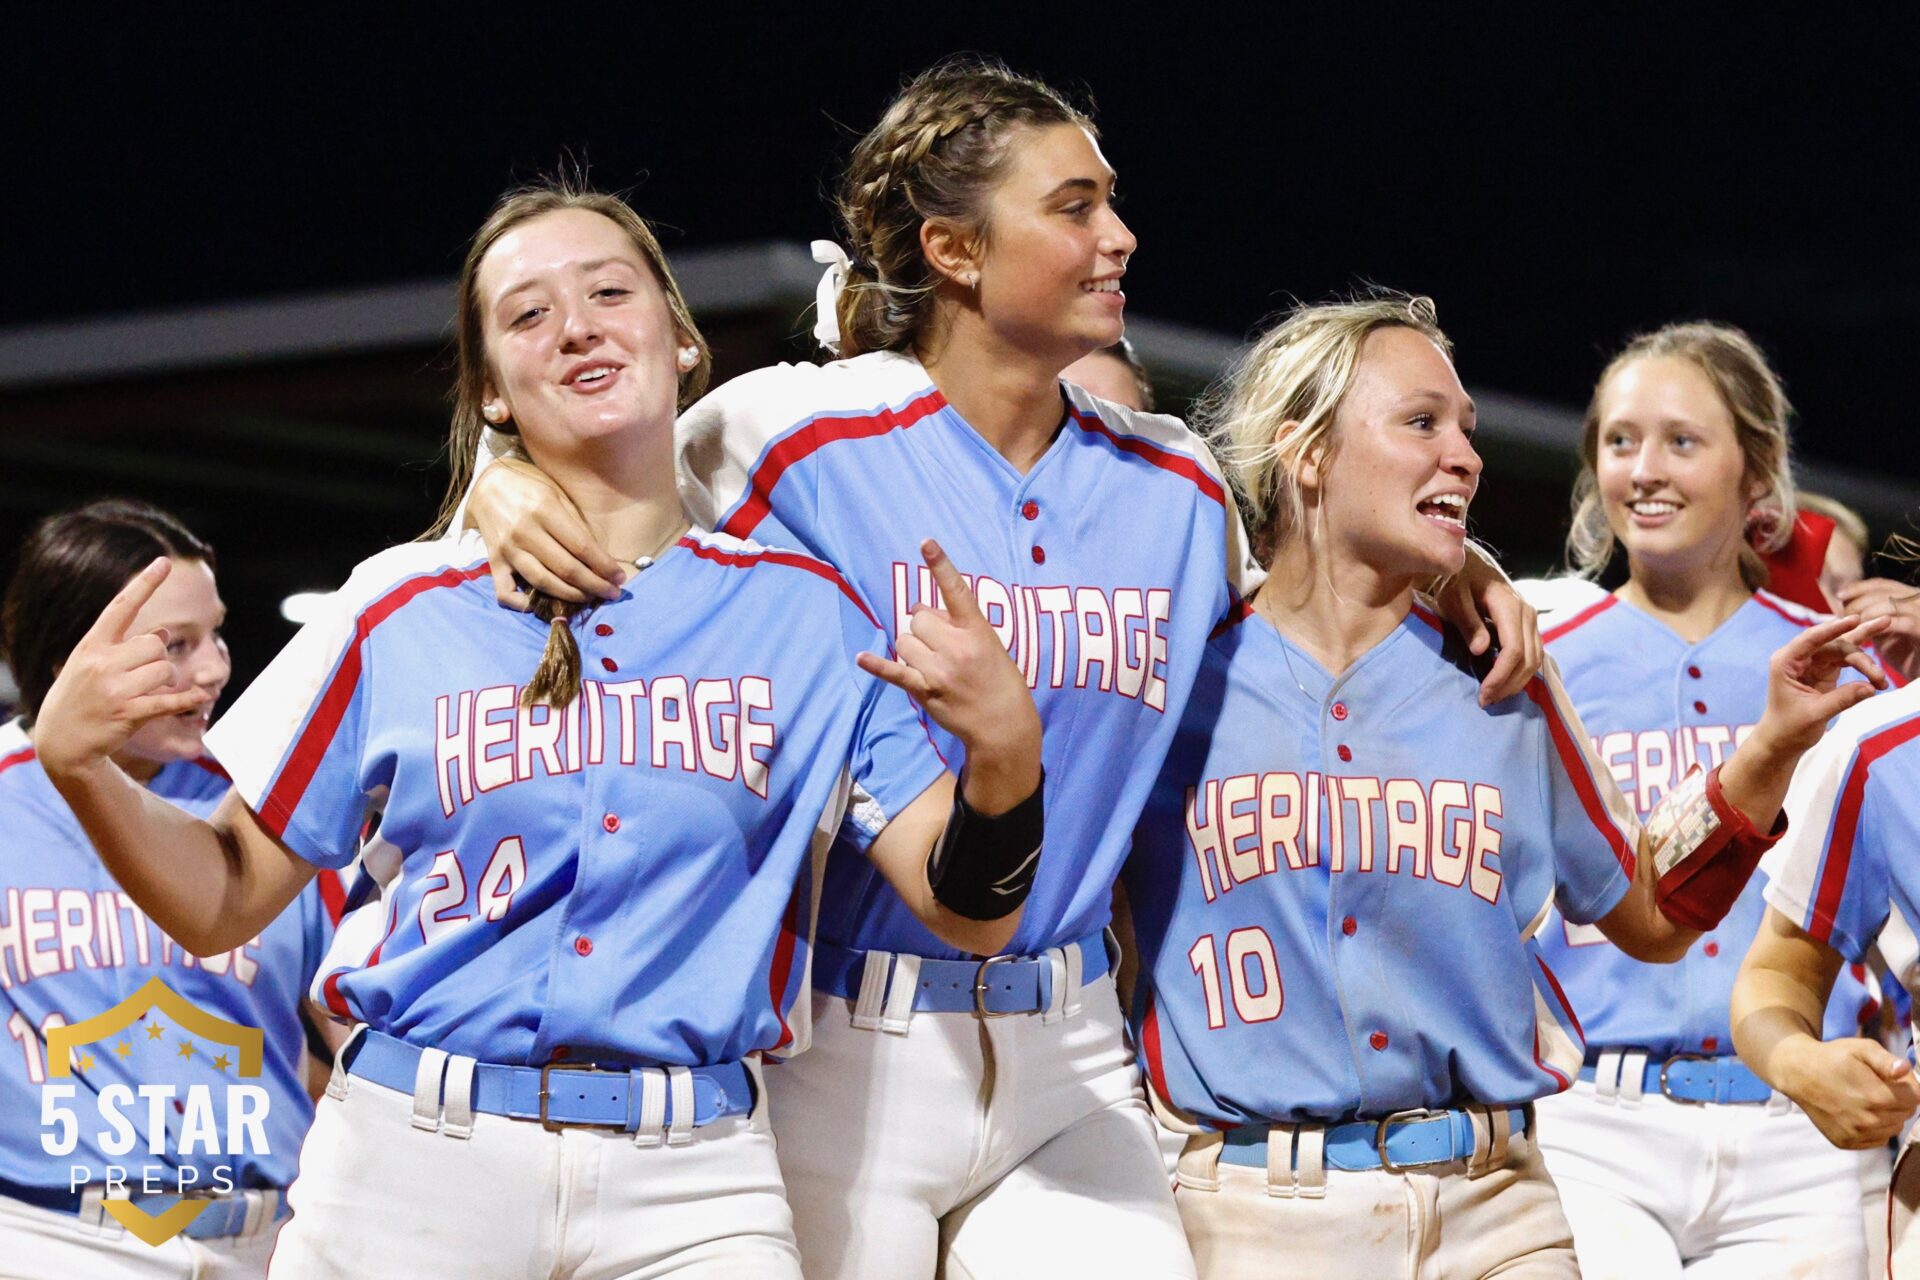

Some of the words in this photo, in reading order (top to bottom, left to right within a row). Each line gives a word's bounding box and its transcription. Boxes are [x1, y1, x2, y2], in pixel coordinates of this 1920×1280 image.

[435, 675, 775, 820] HERITAGE
[1185, 771, 1503, 905] HERITAGE
[1187, 925, 1284, 1030] 10
